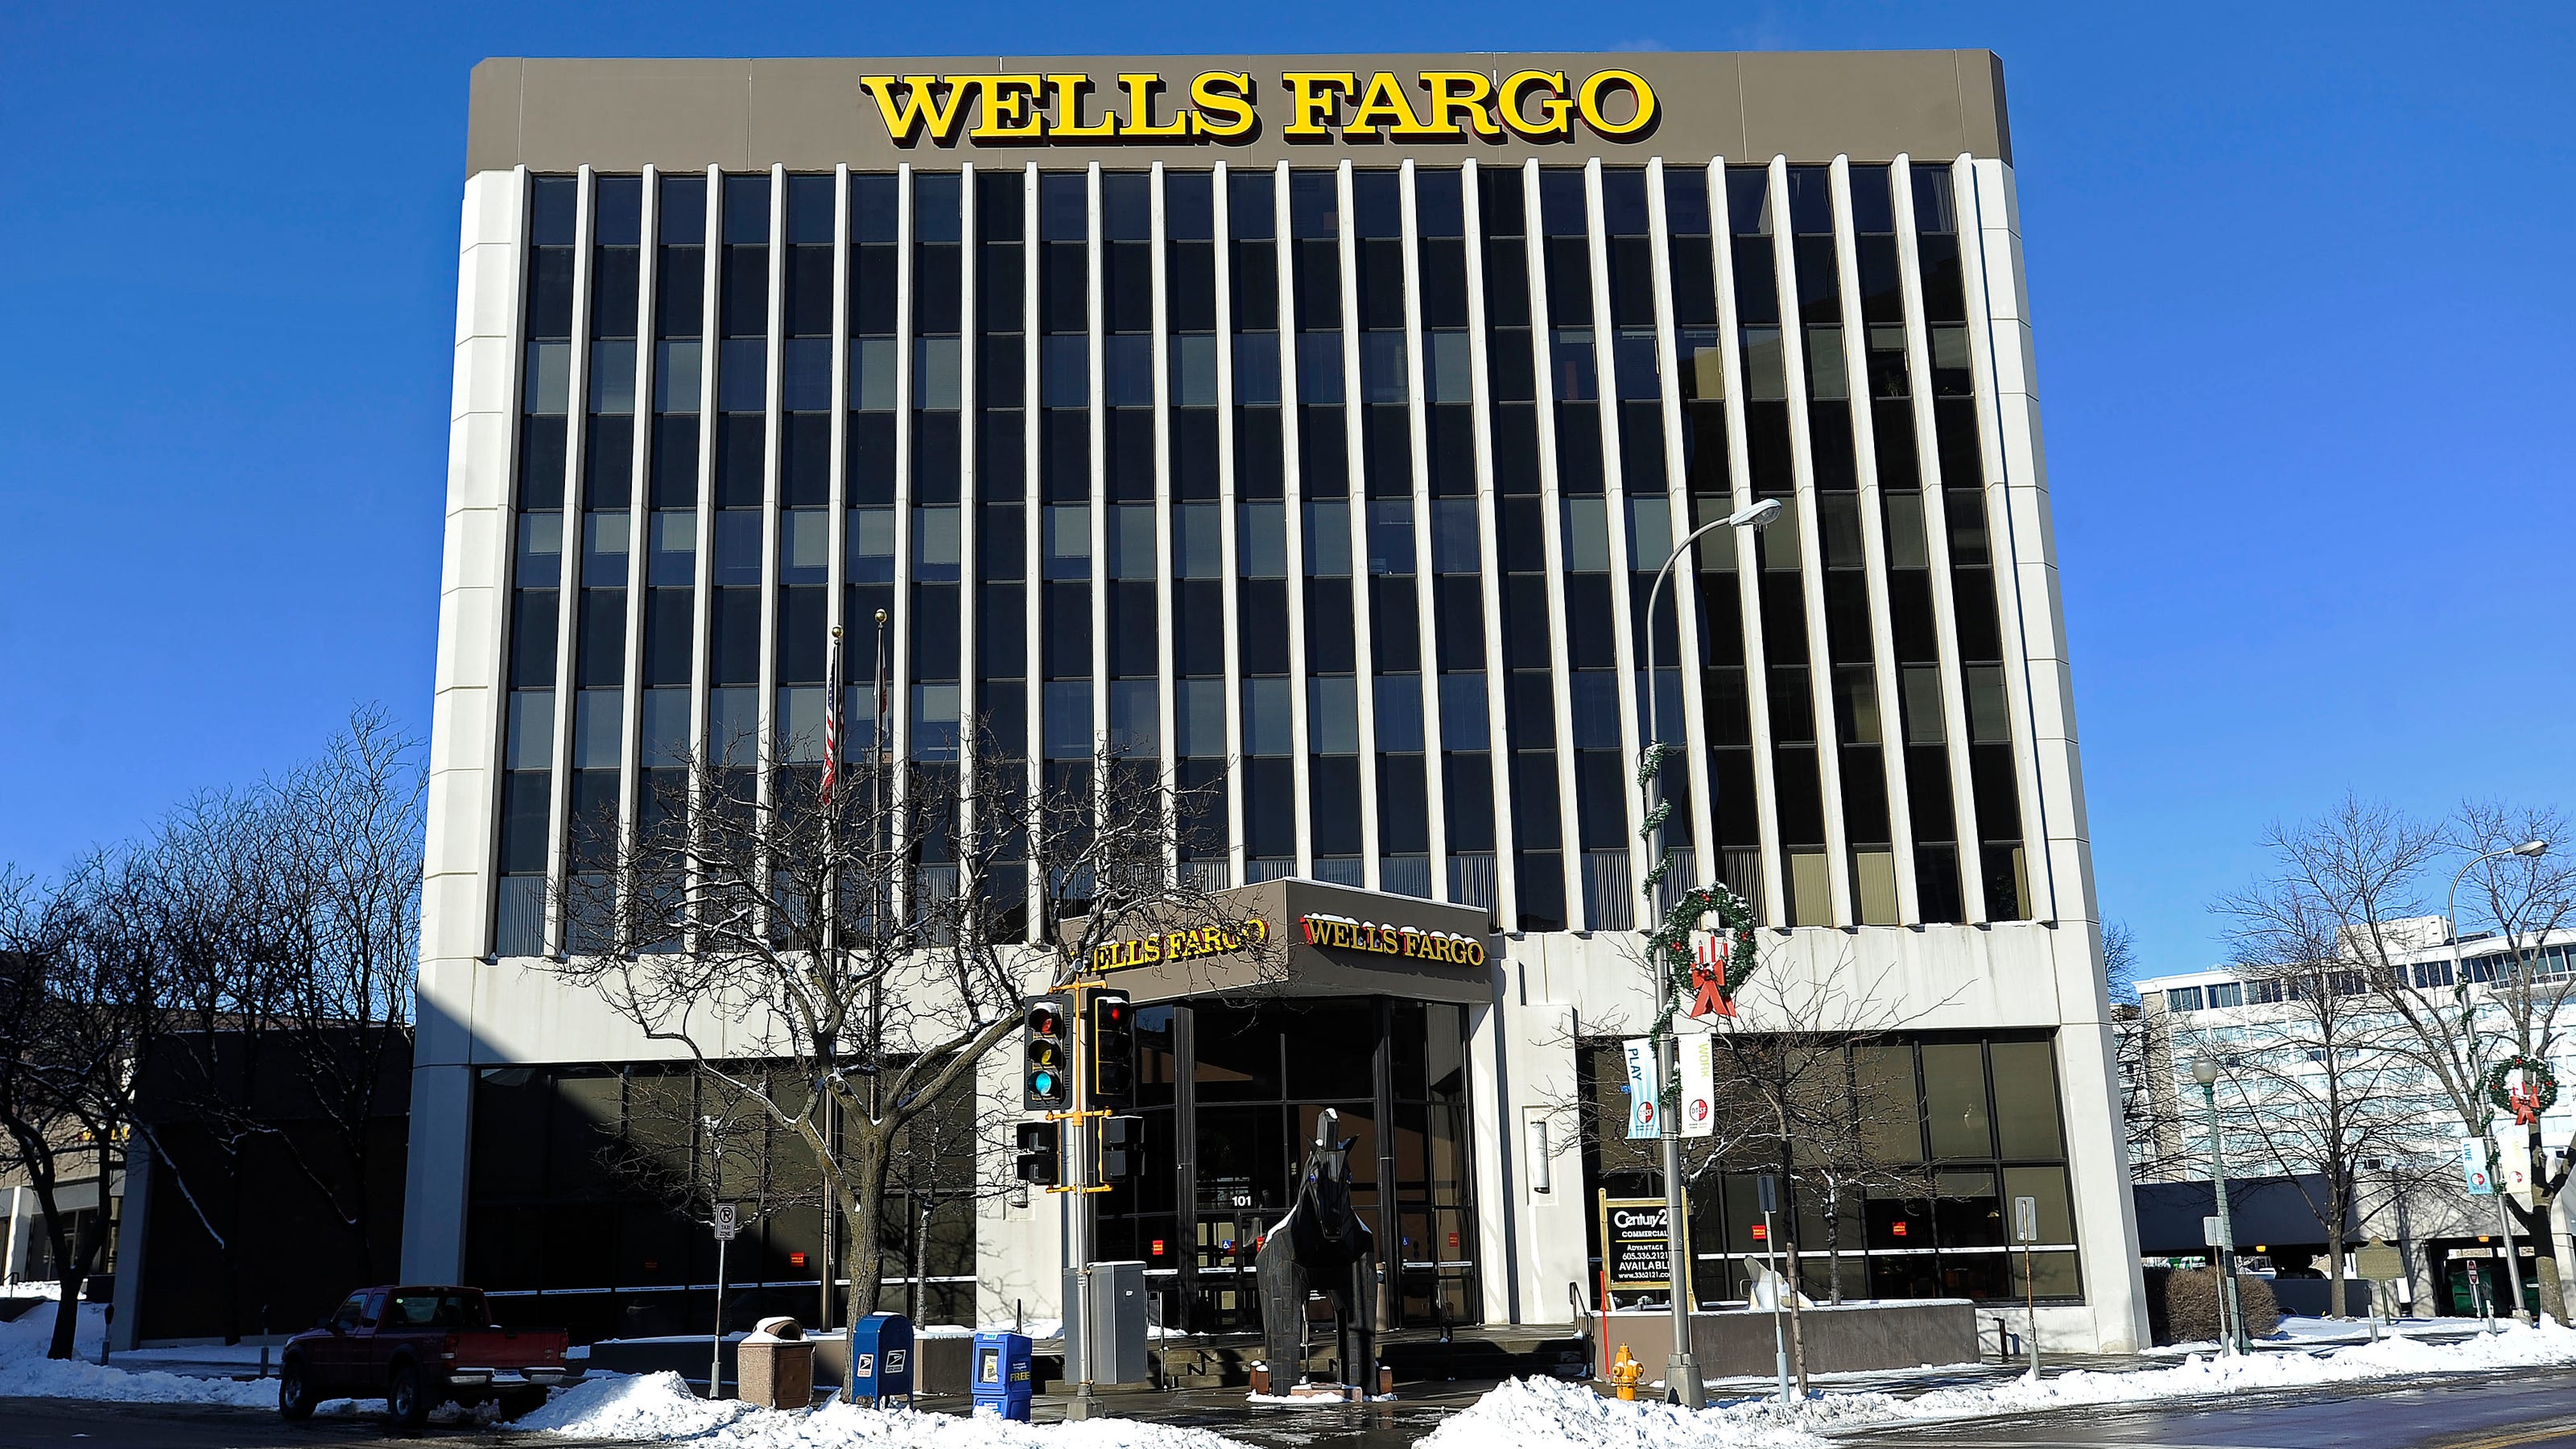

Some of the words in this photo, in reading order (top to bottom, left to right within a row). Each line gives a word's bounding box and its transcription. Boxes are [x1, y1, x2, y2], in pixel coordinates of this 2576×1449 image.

[860, 71, 1262, 149] WELLS
[1282, 68, 1662, 146] FARGO
[1071, 935, 1162, 973] ELLS
[1301, 917, 1398, 955] WELLS
[1402, 931, 1485, 967] FARGO
[1628, 1048, 1642, 1081] PLAY
[1698, 1042, 1710, 1077] WORK
[2463, 1144, 2472, 1162] LIVE
[1232, 1195, 1251, 1207] 101
[1621, 1230, 1668, 1238] COMMERCIAL
[1622, 1252, 1668, 1260] 605.336.2121
[1010, 1372, 1030, 1381] FREE
